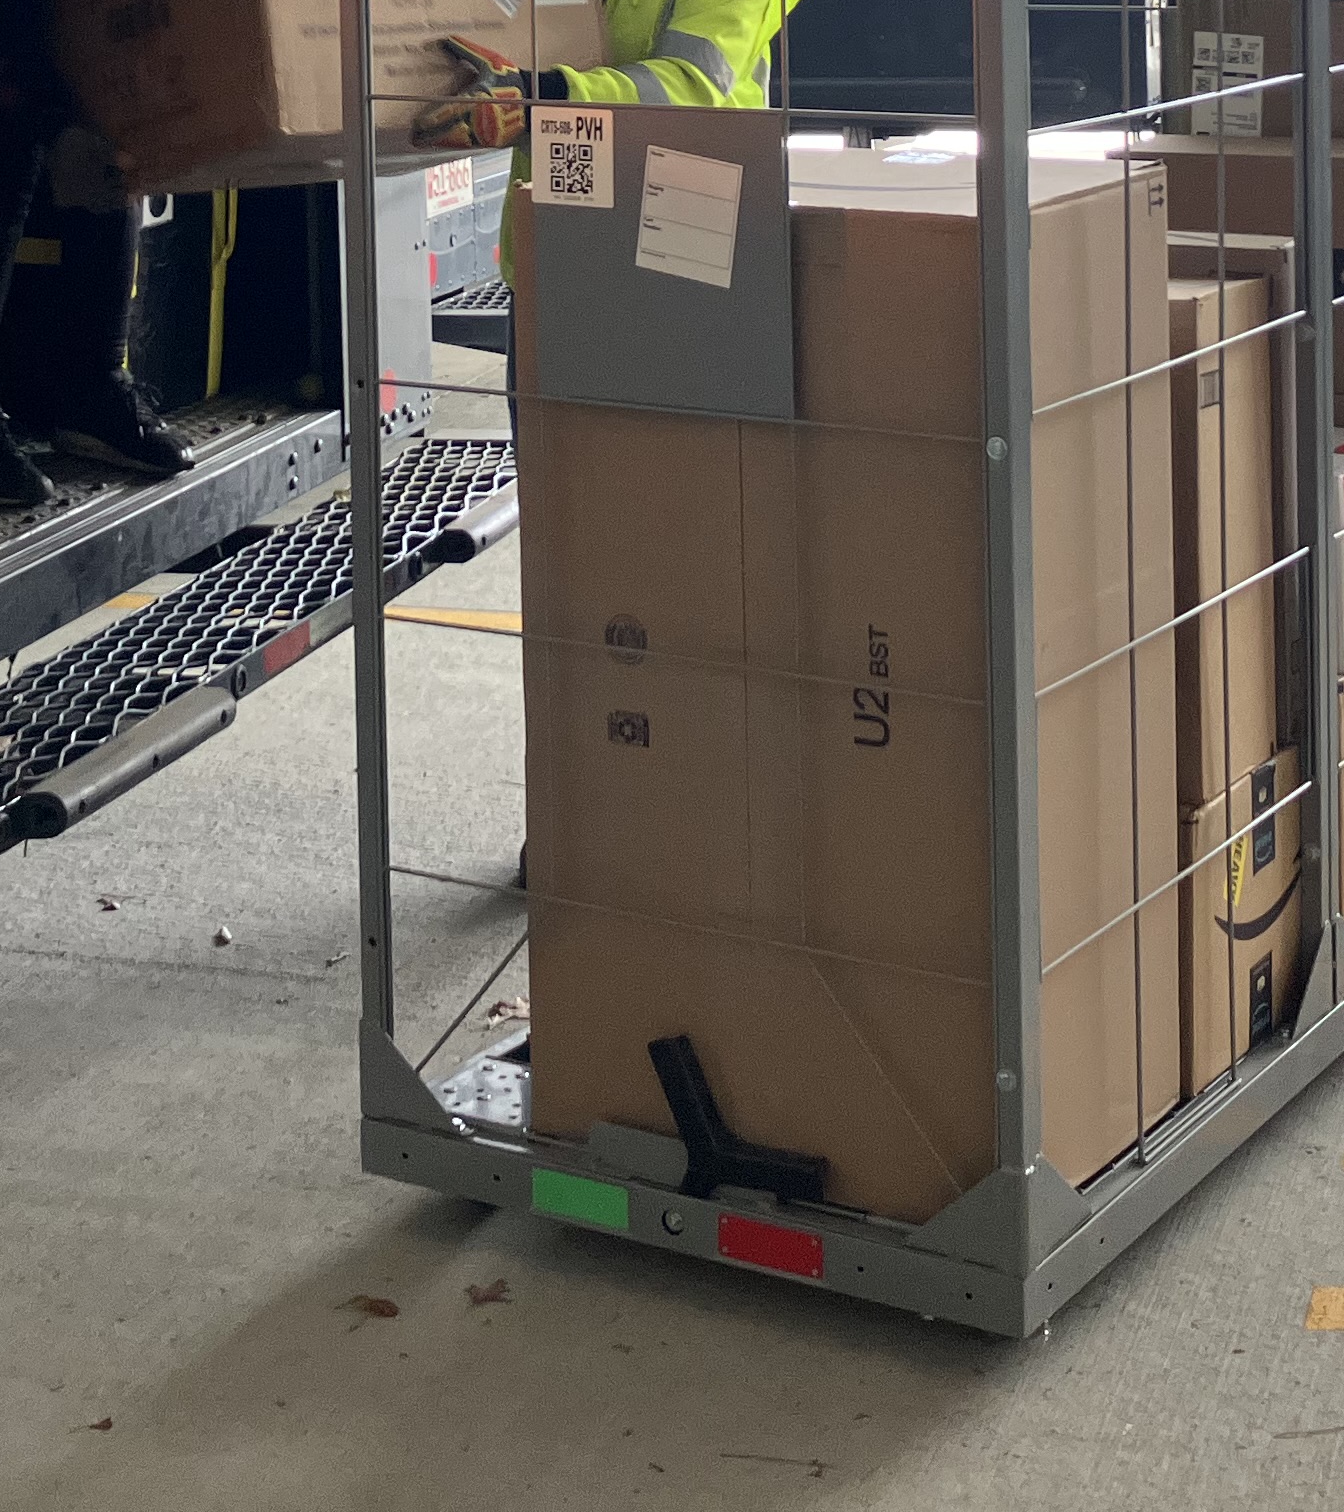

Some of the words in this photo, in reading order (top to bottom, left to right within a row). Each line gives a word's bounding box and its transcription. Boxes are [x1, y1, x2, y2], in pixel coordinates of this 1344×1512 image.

[575, 116, 603, 142] PVH
[867, 622, 890, 678] BST
[853, 687, 891, 748] U2
